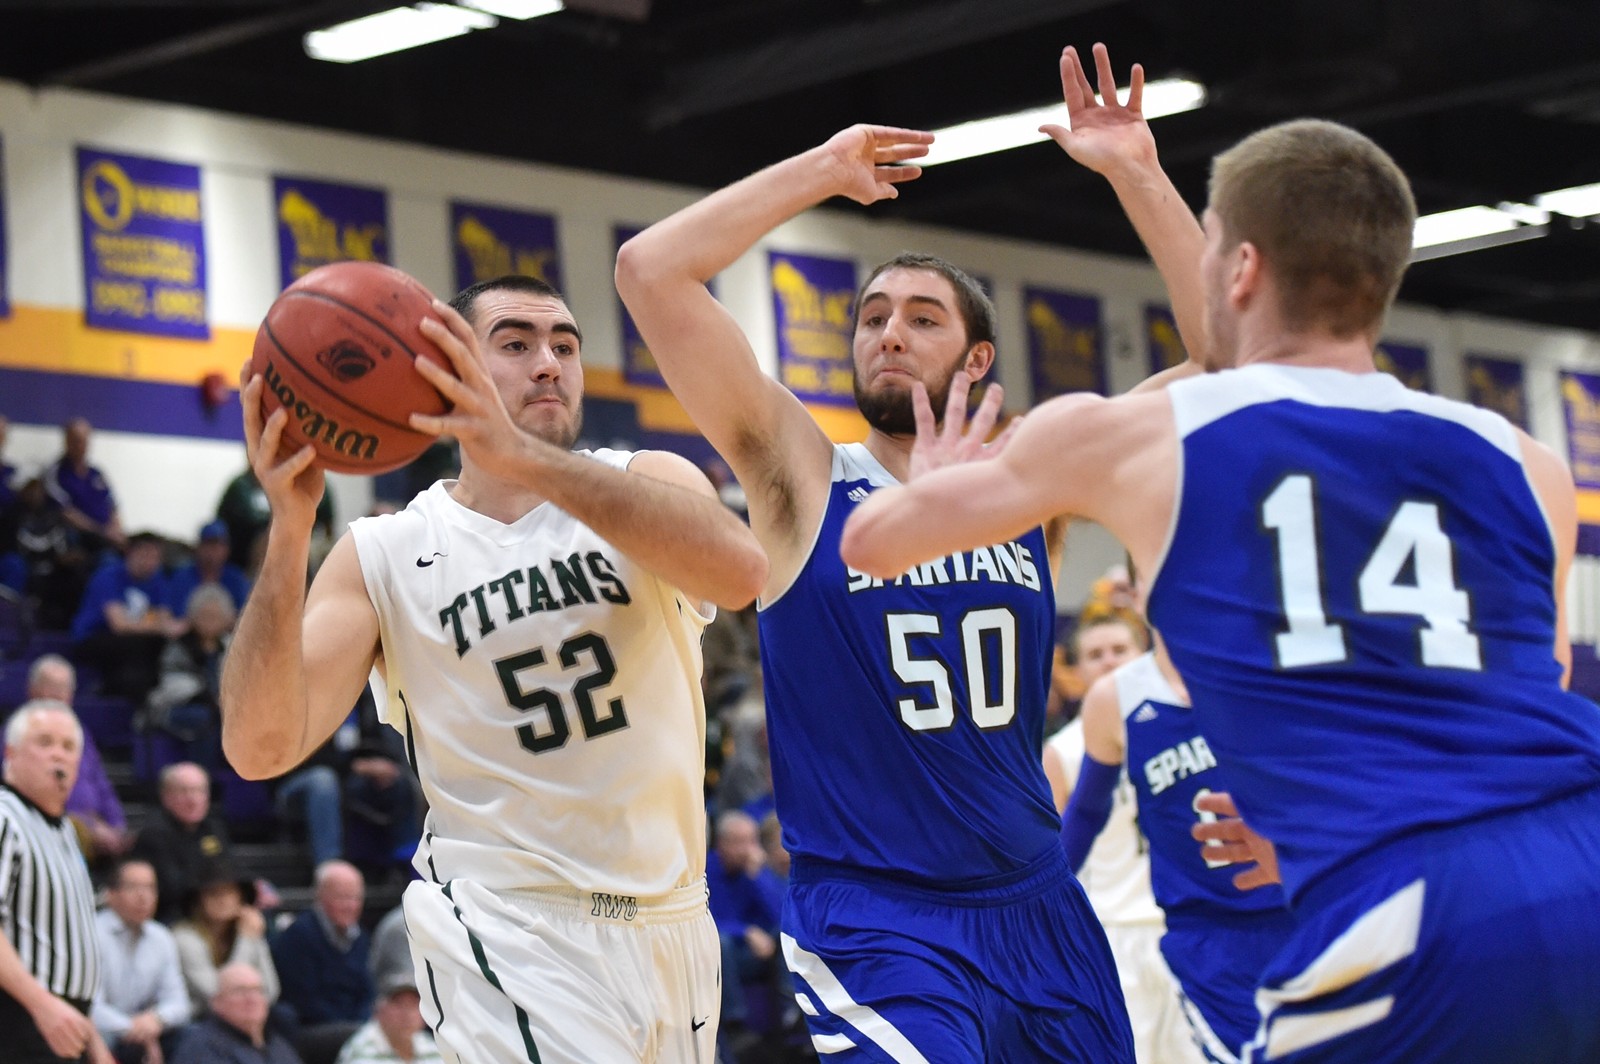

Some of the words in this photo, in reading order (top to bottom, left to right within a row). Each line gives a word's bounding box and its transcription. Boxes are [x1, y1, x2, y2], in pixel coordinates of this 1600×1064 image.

[264, 360, 380, 461] Wilson
[438, 549, 632, 661] TITANS
[847, 541, 1042, 593] SRTANS
[1261, 474, 1483, 671] 14
[491, 630, 631, 756] 52
[885, 606, 1017, 732] 50
[591, 892, 638, 921] IWU
